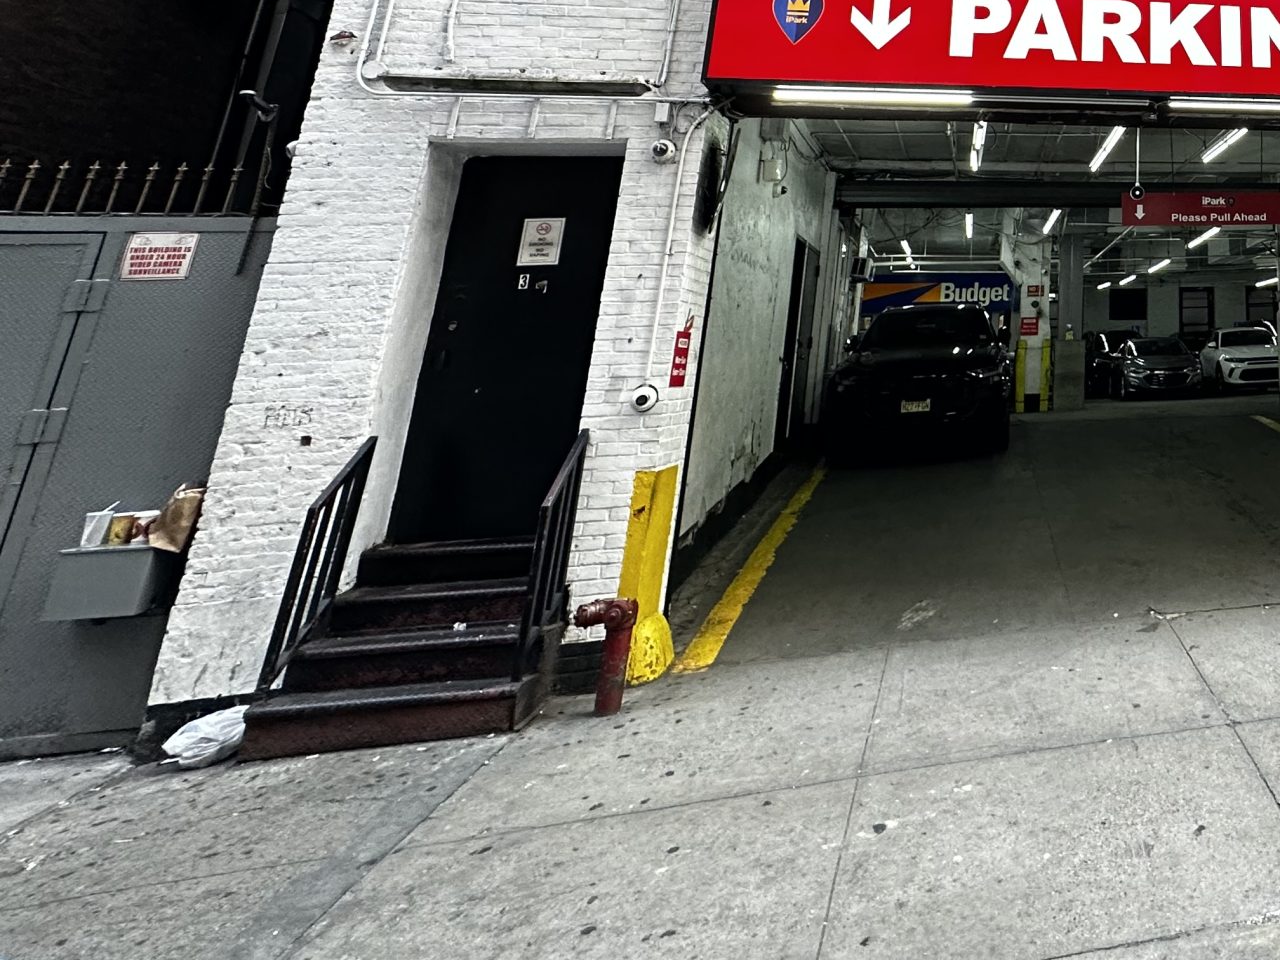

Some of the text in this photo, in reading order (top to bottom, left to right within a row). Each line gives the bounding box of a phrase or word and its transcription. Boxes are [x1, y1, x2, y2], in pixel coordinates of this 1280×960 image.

[785, 15, 808, 24] iPark
[1201, 196, 1226, 205] iPark
[1171, 212, 1267, 222] Please Pull Ahead
[128, 268, 180, 276] SURVEILLANCE
[520, 274, 528, 289] 3
[939, 282, 1010, 307] Budget
